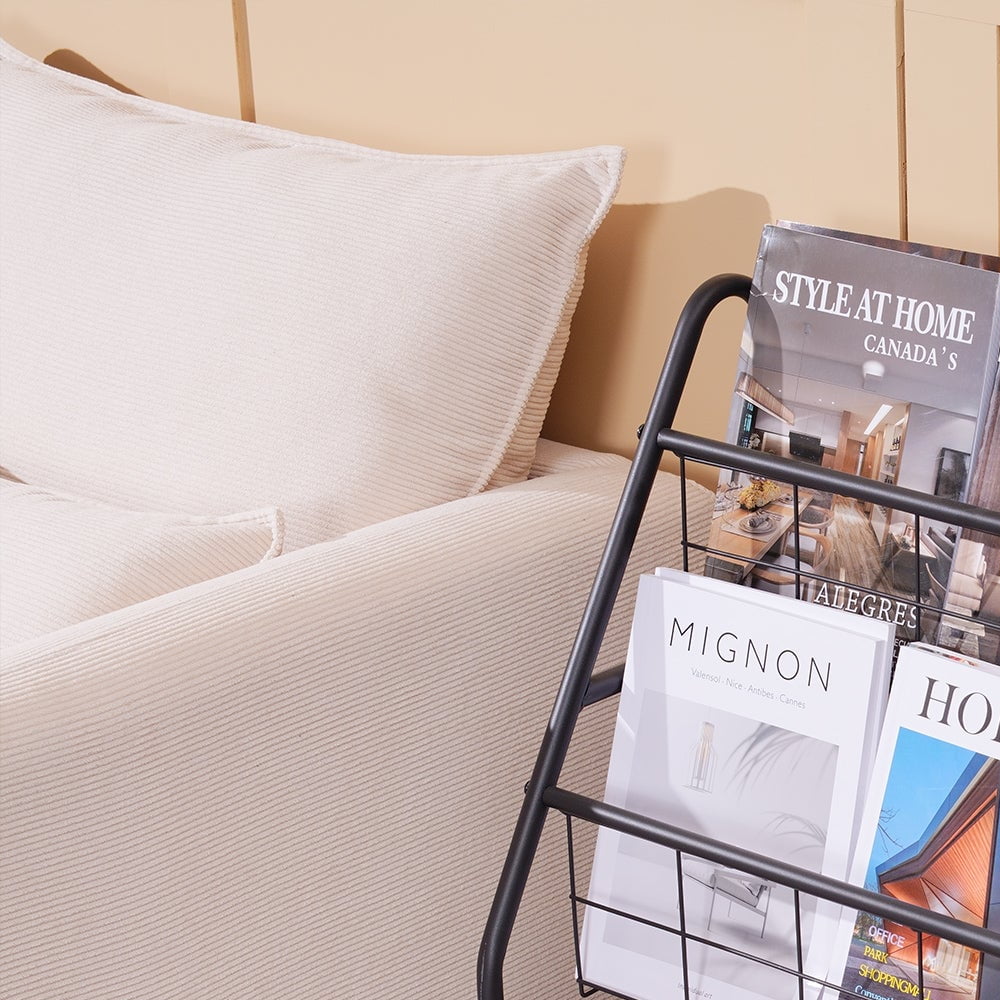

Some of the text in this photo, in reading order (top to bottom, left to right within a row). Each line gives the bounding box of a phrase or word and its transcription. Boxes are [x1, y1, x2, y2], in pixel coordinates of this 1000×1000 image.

[773, 270, 976, 344] STYLE AT HOME
[669, 617, 831, 691] MIGNON
[726, 678, 743, 690] Nice
[747, 684, 774, 700] Antibes
[779, 693, 806, 709] Cannes
[868, 925, 906, 948] OFFICE
[863, 945, 889, 964] PARK
